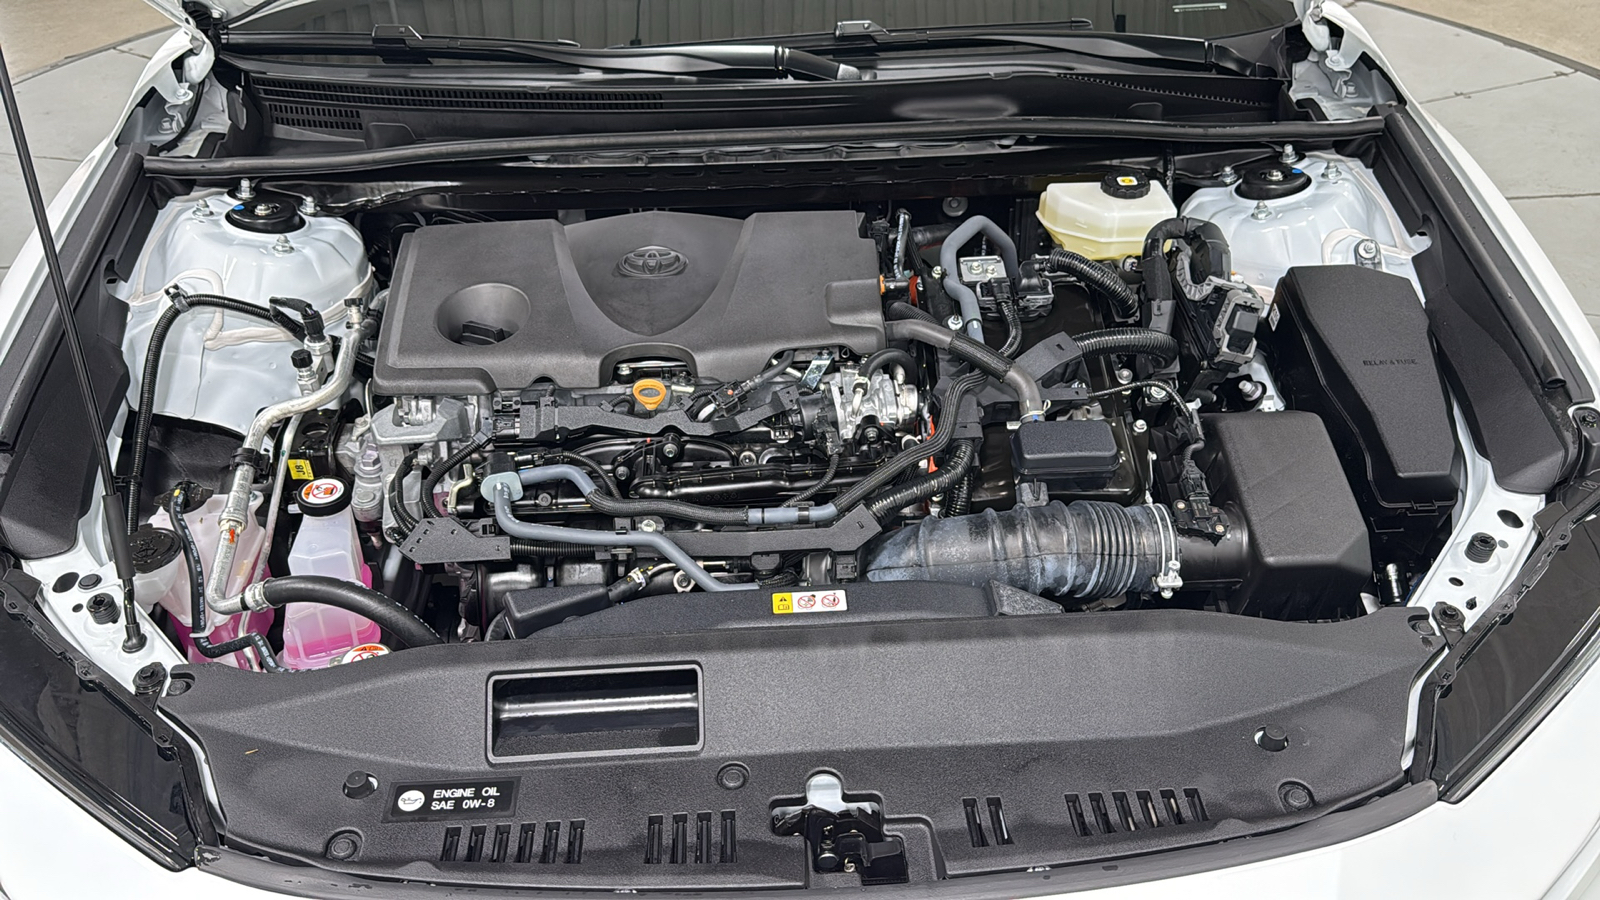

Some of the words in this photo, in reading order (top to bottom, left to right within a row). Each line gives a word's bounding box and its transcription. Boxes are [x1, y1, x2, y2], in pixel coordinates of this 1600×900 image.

[433, 788, 475, 799] ENGINE
[481, 786, 500, 797] OIL
[430, 800, 455, 810] SAE
[462, 798, 495, 809] 0W-8
